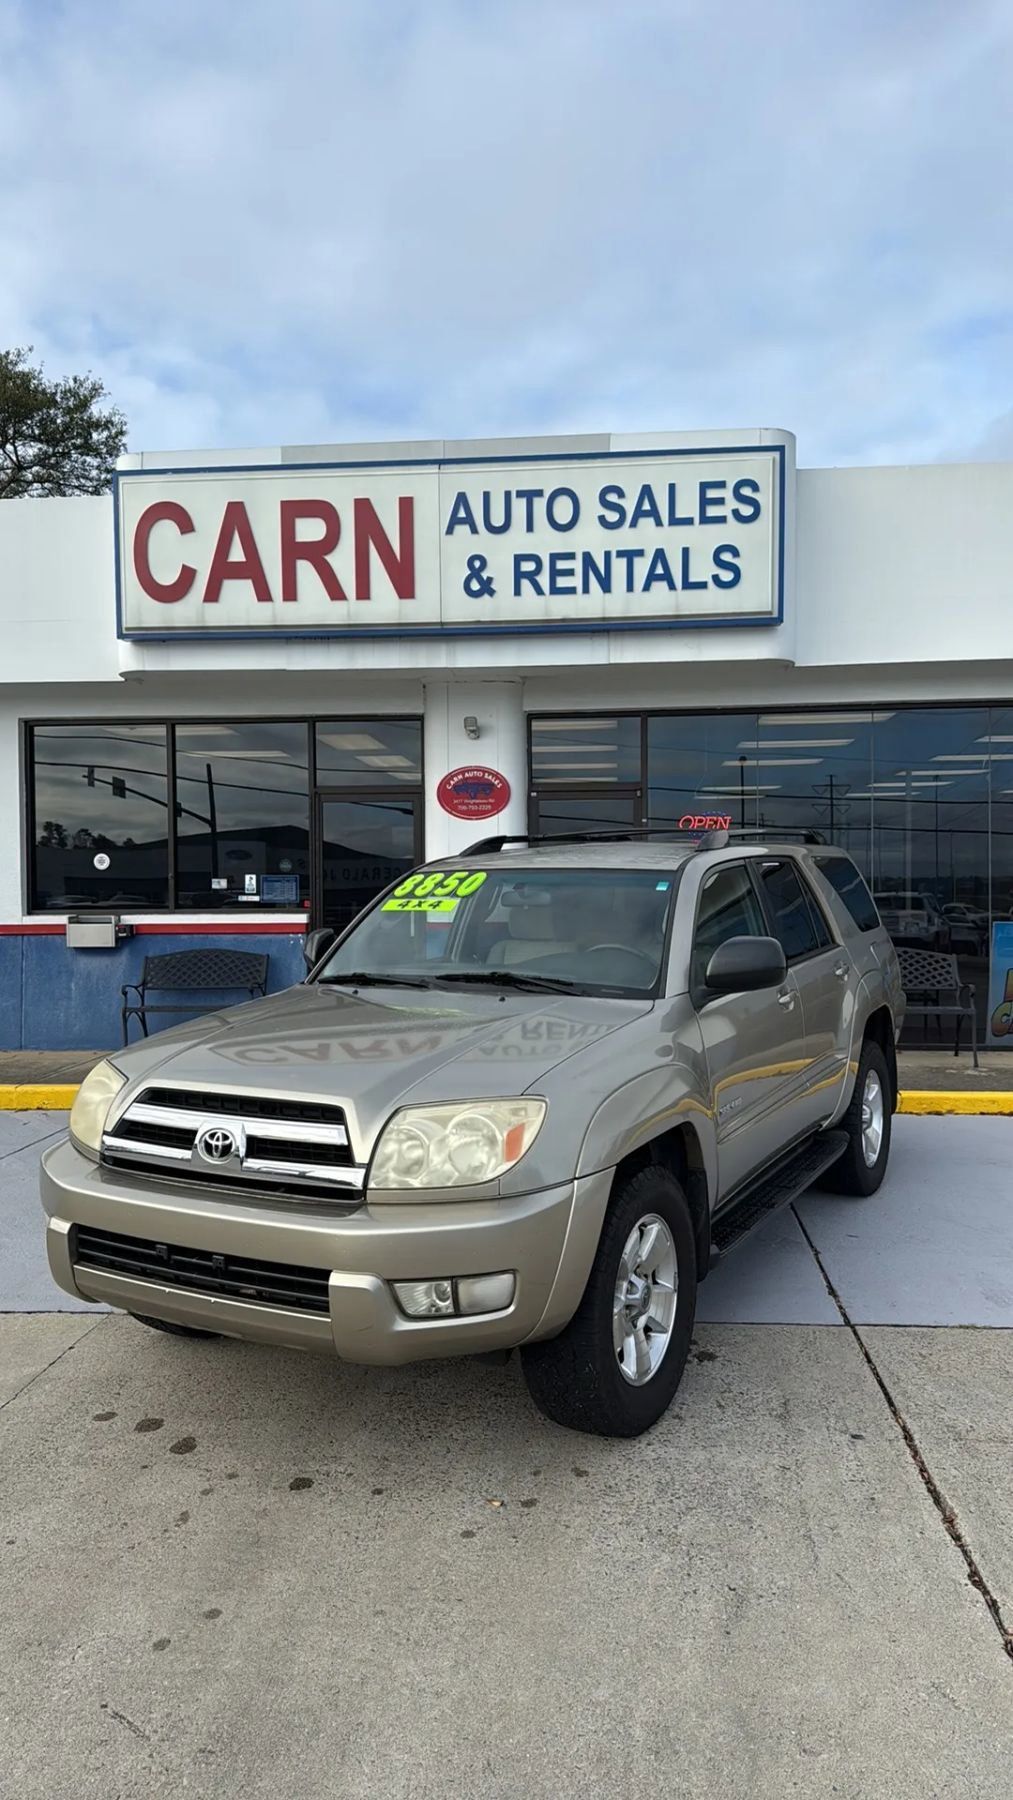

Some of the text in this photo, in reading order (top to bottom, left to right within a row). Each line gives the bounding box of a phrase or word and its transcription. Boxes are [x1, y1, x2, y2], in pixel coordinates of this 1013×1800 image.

[445, 478, 761, 535] AUTO SALES
[133, 496, 415, 603] CARN
[462, 544, 742, 598] & RENTALS
[446, 775, 463, 789] CARN
[484, 773, 502, 788] SALES
[679, 815, 732, 829] OPEN
[394, 871, 487, 897] 8850
